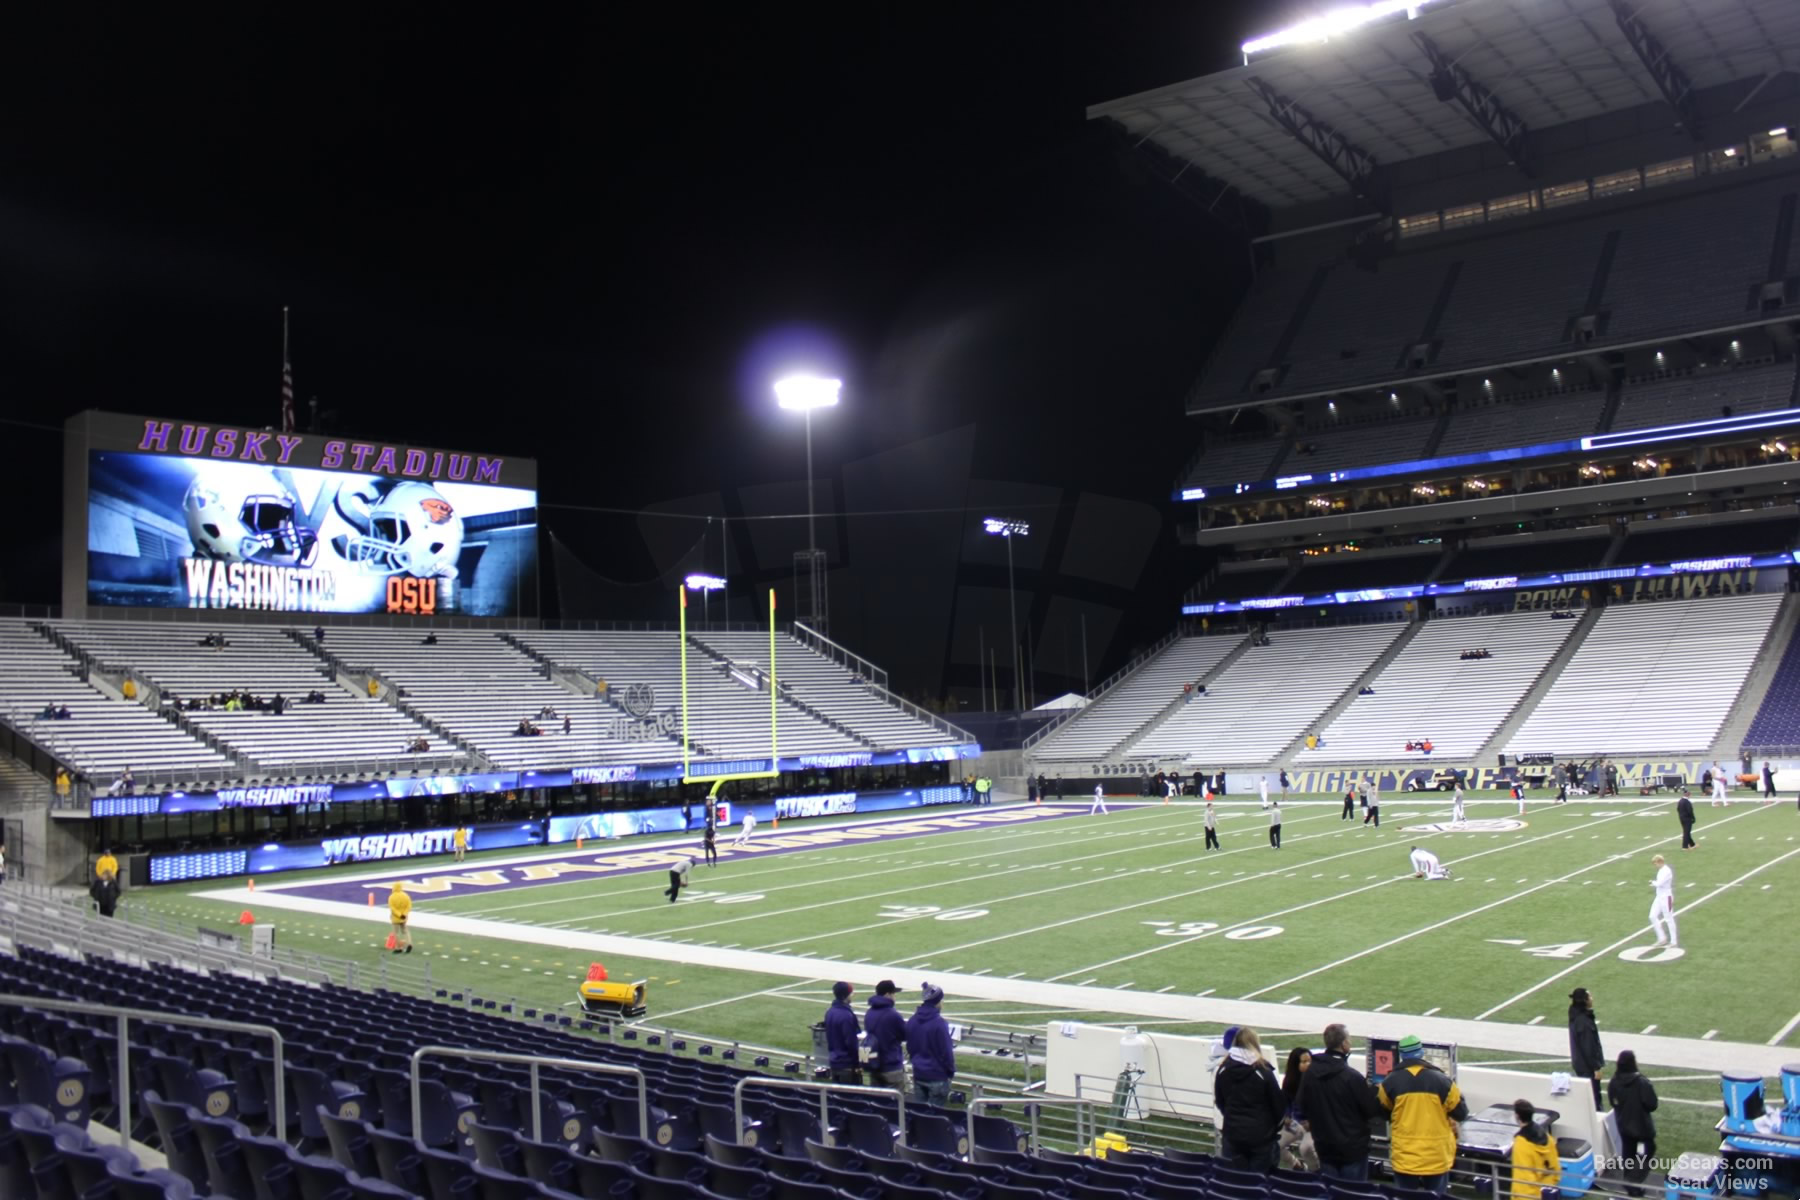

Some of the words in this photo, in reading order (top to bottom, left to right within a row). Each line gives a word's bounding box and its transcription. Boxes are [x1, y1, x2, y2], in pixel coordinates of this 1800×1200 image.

[138, 420, 302, 464] HUSKY
[321, 440, 503, 483] STADIUM
[185, 557, 336, 602] WASHINGTON
[386, 575, 436, 611] OSU
[606, 711, 676, 742] Allstate
[571, 765, 637, 784] HUSKIES
[1288, 768, 1414, 793] MIGHTY
[216, 784, 333, 809] WASHINGTON
[775, 792, 857, 819] HUSKIES
